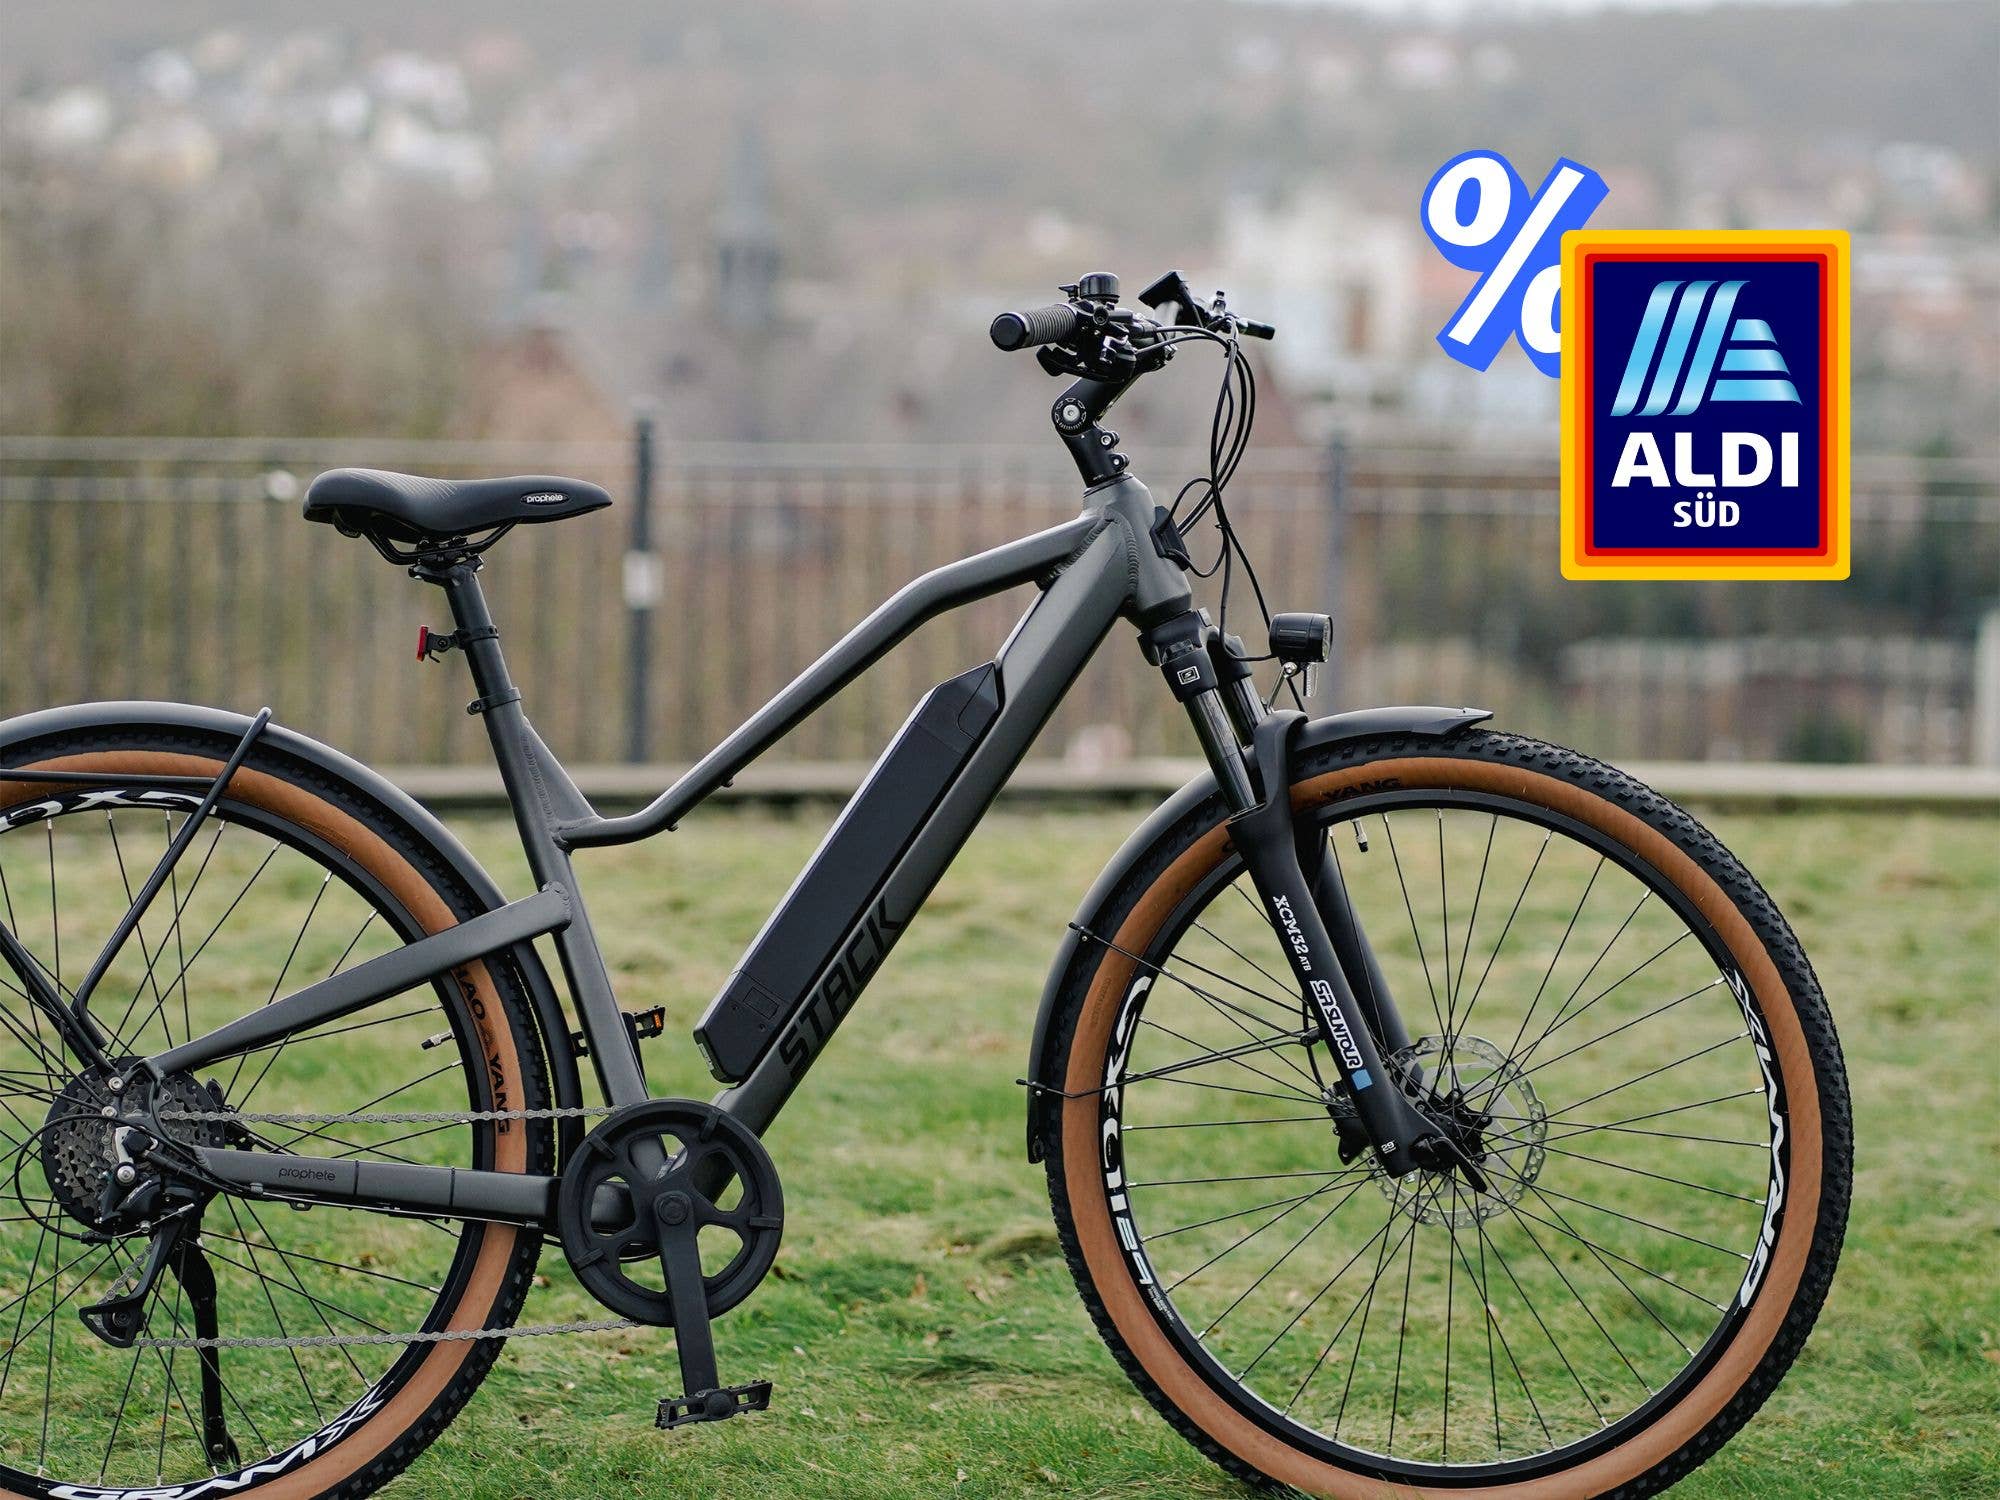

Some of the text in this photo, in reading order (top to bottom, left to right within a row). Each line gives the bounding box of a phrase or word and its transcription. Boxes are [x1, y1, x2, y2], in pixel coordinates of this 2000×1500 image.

[526, 493, 563, 503] prophete
[1321, 777, 1401, 800] YANG
[1299, 955, 1312, 972] ATB
[779, 895, 902, 1080] STACK
[1325, 1006, 1364, 1069] SUNTOUR
[489, 1054, 510, 1135] YANG
[278, 1167, 336, 1181] prophete
